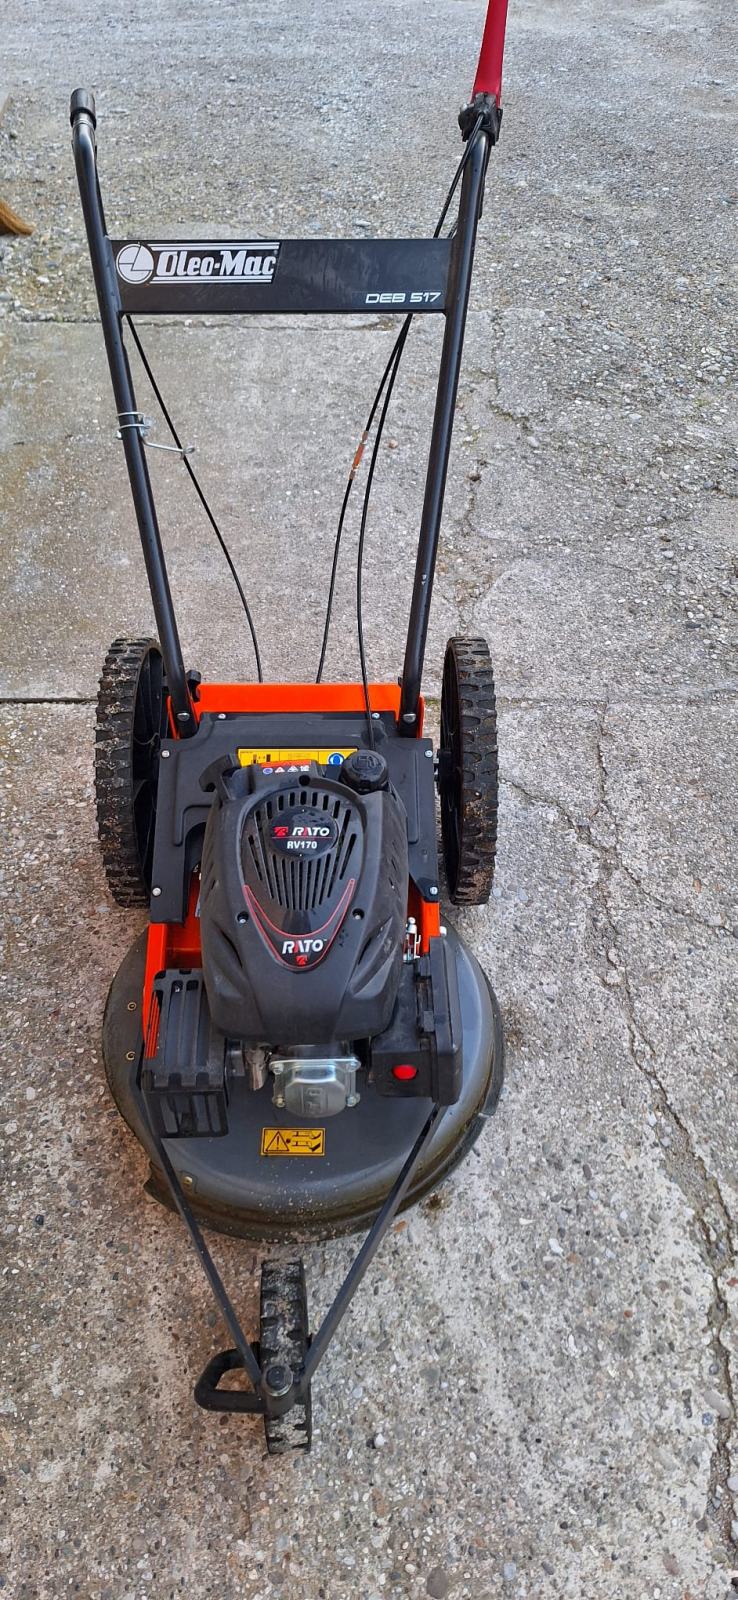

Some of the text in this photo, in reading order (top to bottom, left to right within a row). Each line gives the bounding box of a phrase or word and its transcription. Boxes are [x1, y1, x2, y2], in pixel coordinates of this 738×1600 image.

[156, 250, 277, 276] Oleo-Mac
[365, 292, 441, 304] DEB 517
[292, 826, 330, 837] RATO
[286, 840, 318, 849] RV170
[282, 939, 324, 955] RATO
